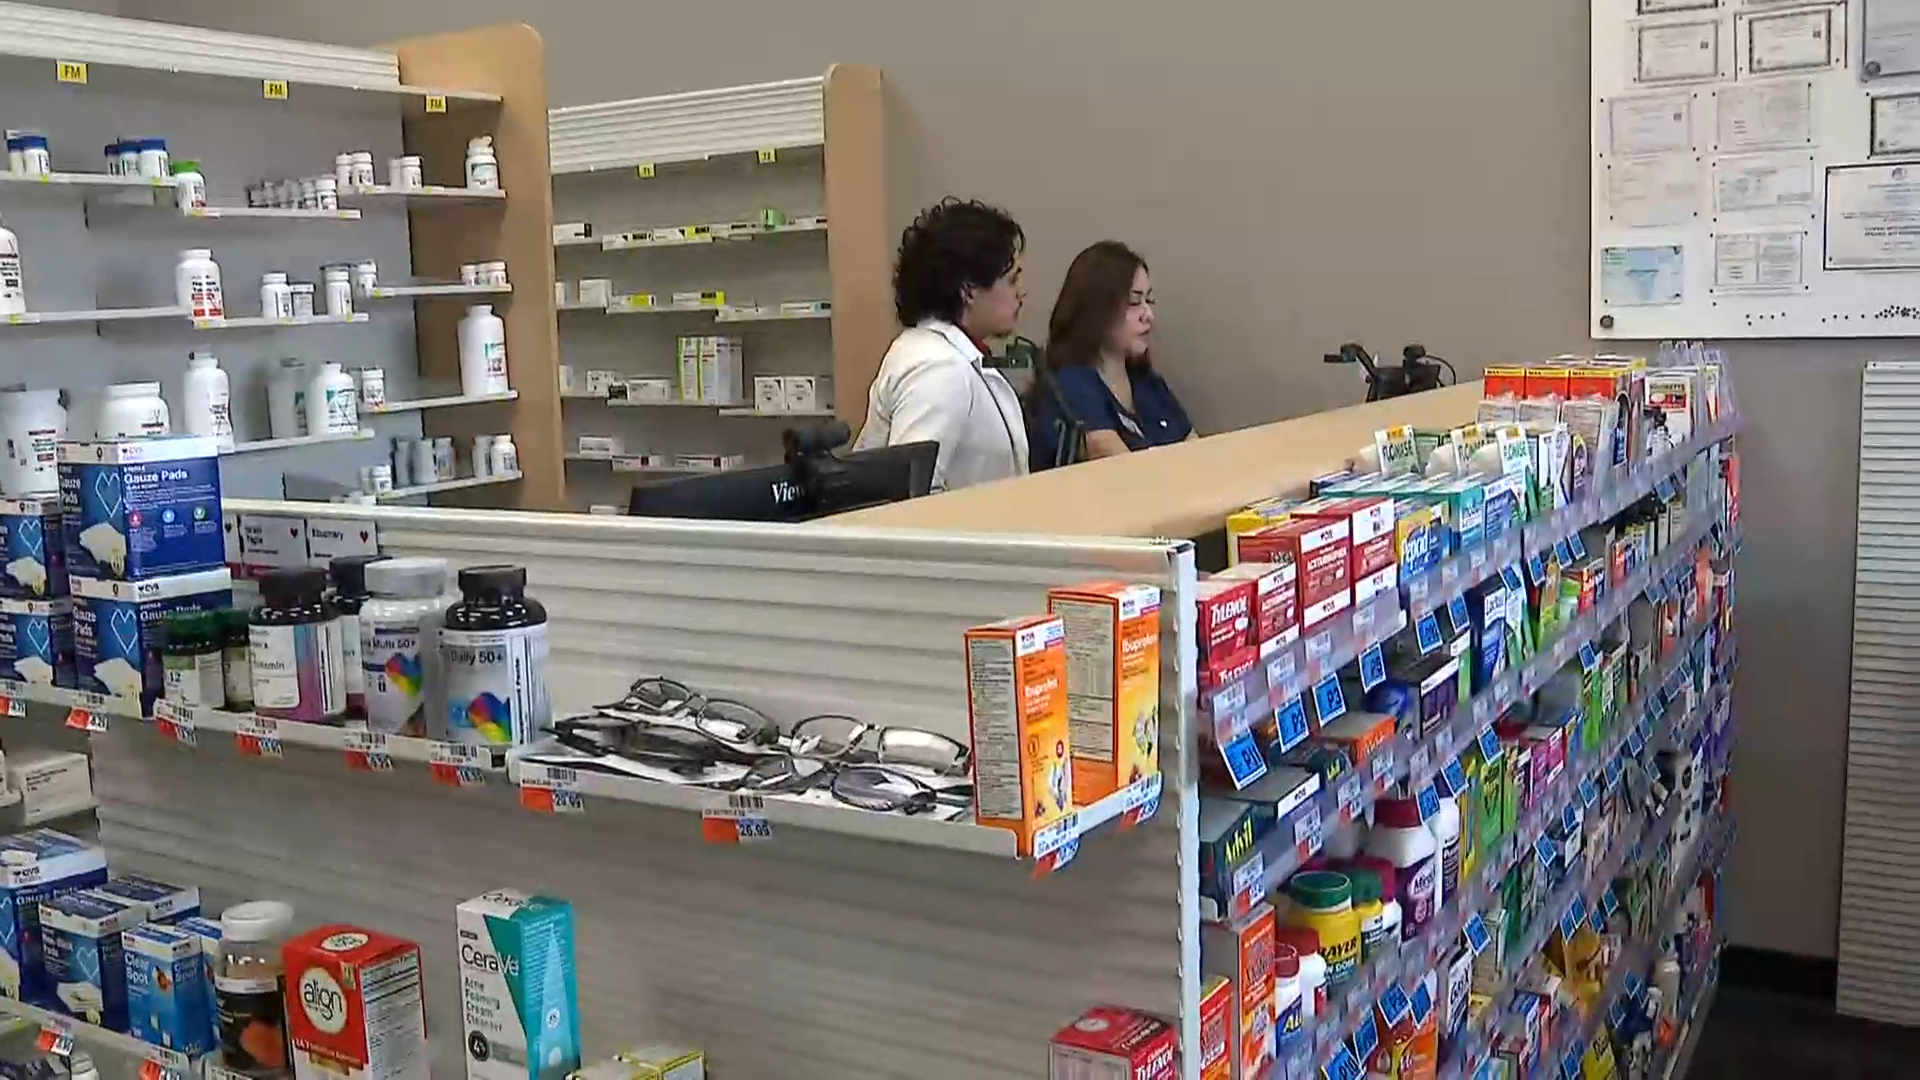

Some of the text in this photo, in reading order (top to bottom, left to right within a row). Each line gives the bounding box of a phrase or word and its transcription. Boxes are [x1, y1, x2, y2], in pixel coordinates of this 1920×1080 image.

[64, 64, 81, 79] FM
[269, 83, 283, 97] FM
[161, 468, 188, 482] Pads
[478, 651, 504, 664] 50+
[461, 943, 519, 976] CeraVe
[303, 978, 343, 1021] align
